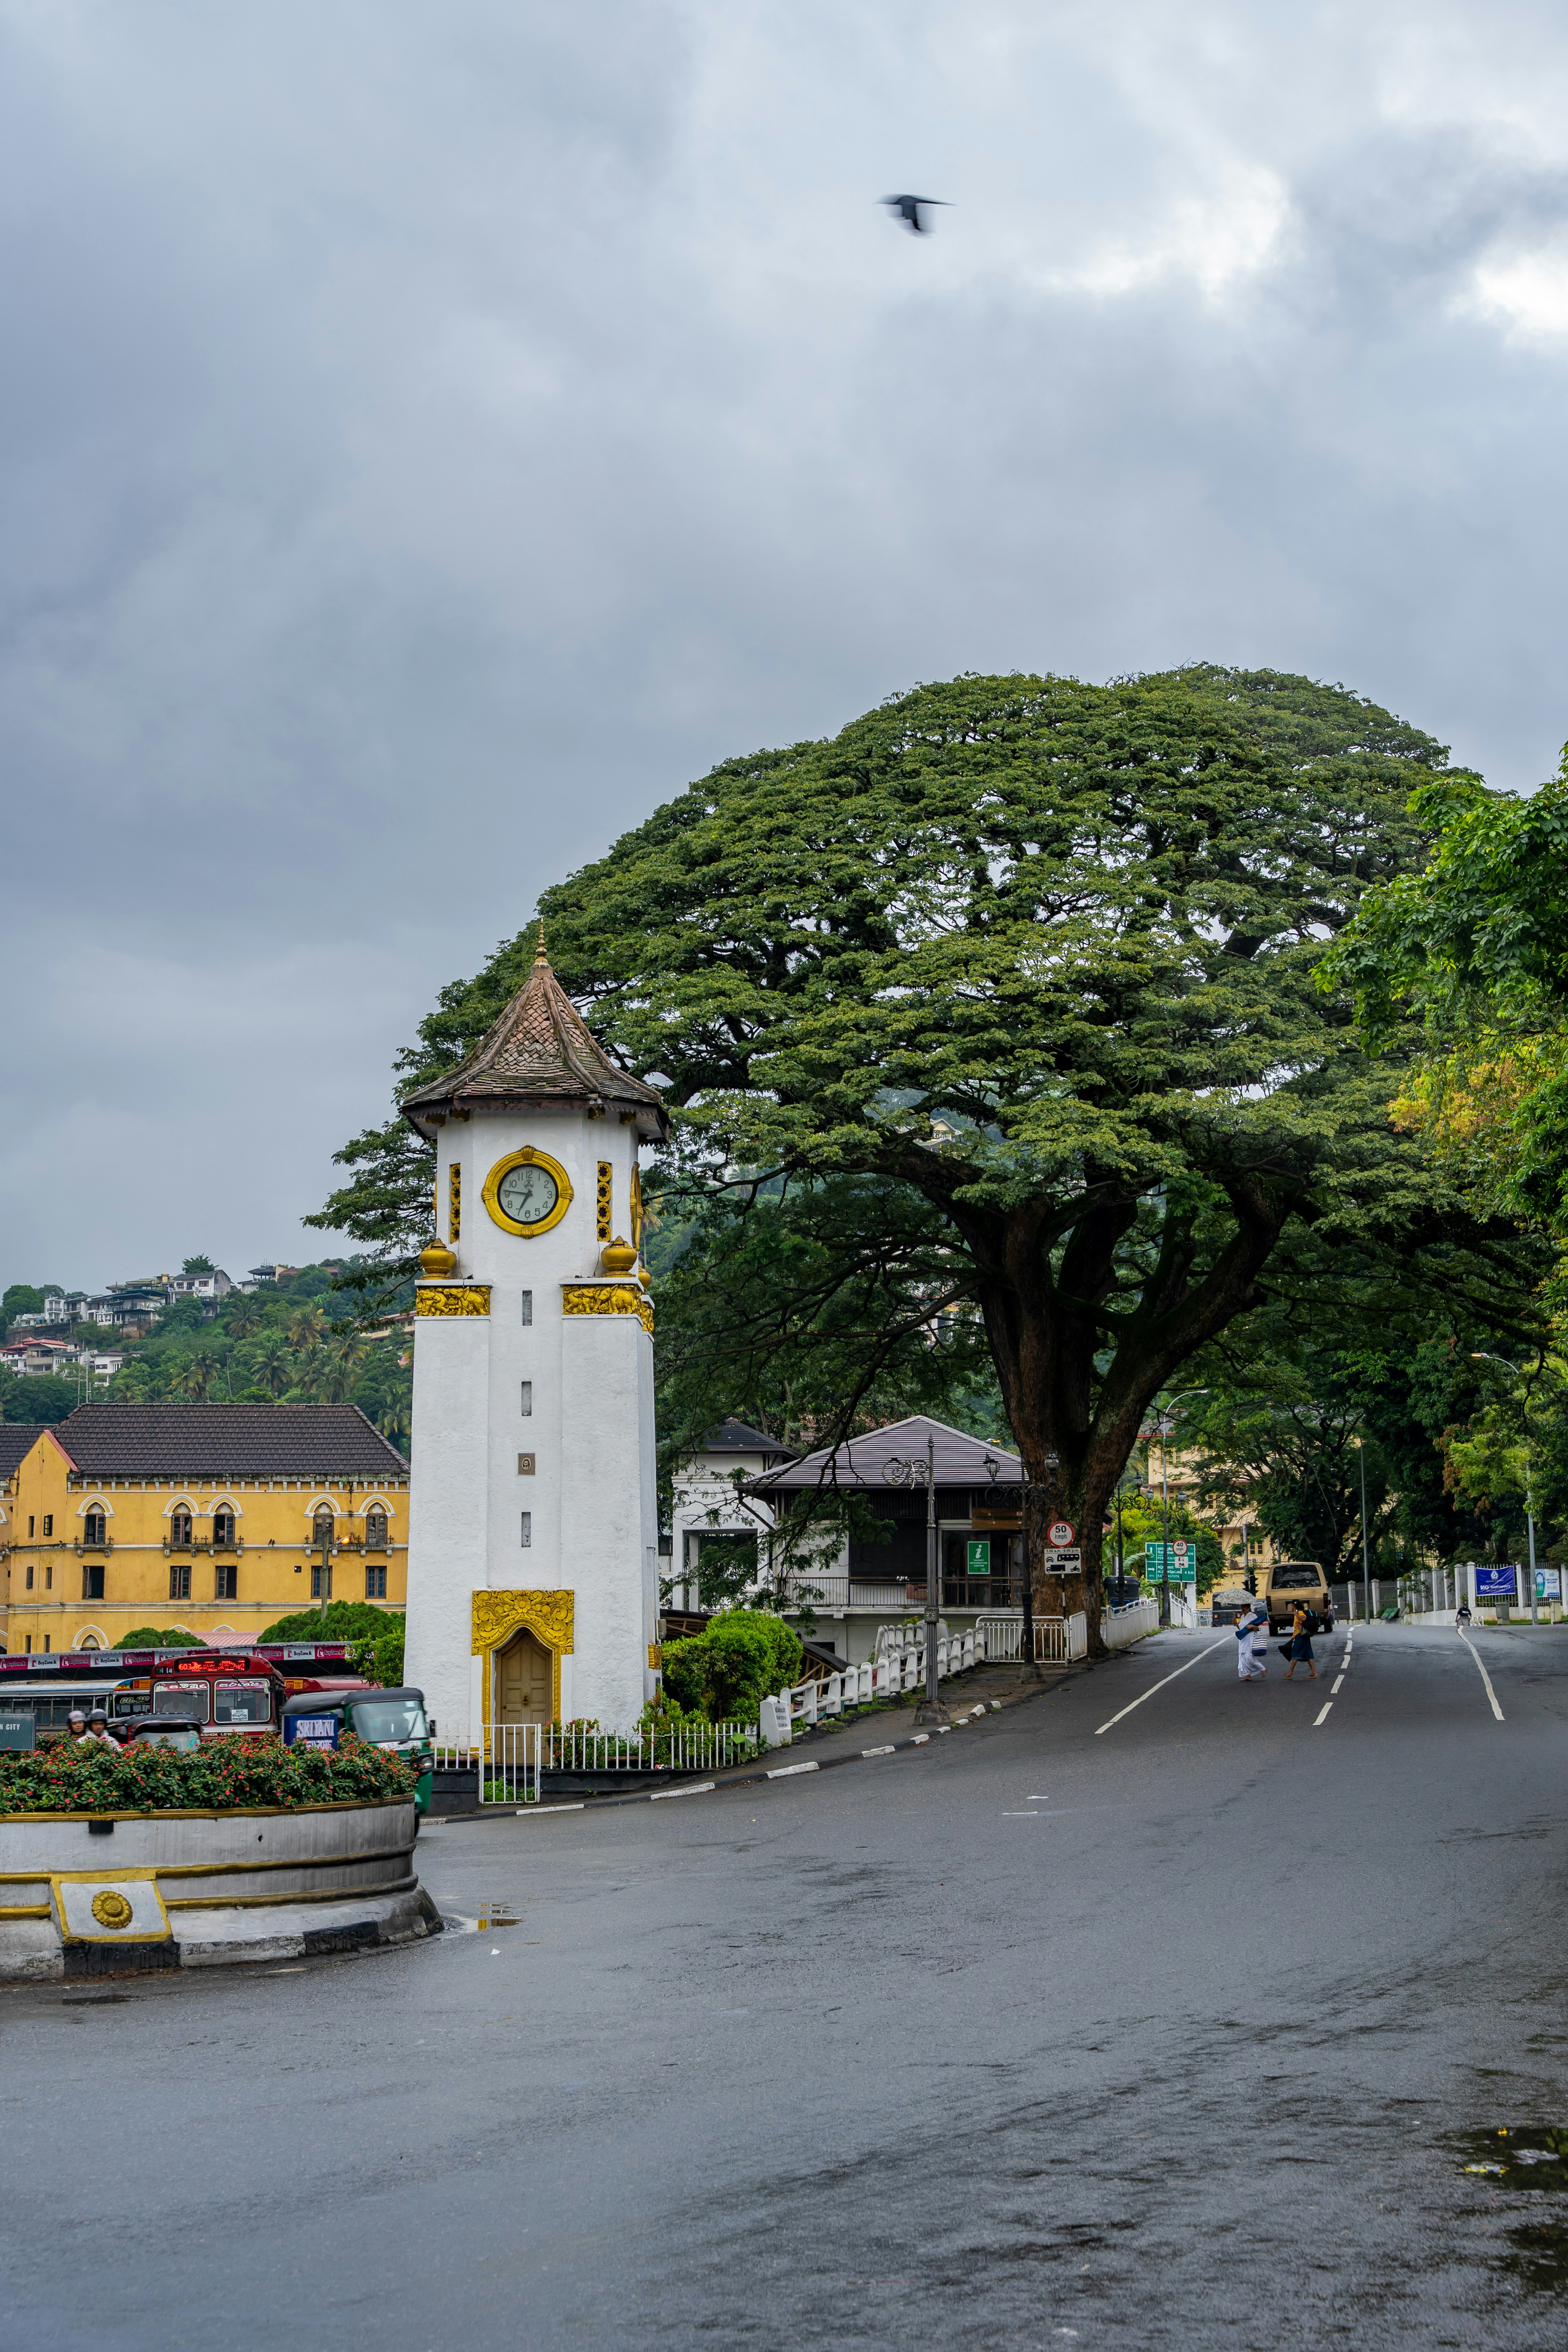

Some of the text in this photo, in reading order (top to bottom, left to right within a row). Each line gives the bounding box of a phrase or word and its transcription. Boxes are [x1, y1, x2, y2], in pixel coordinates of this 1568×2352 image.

[518, 1173, 523, 1181] 11
[526, 1170, 533, 1178] 12
[509, 1180, 517, 1188] 10
[544, 1180, 549, 1188] 2
[547, 1191, 553, 1199] 3
[535, 1208, 540, 1216] 5
[296, 1720, 335, 1738] SRIYANI
